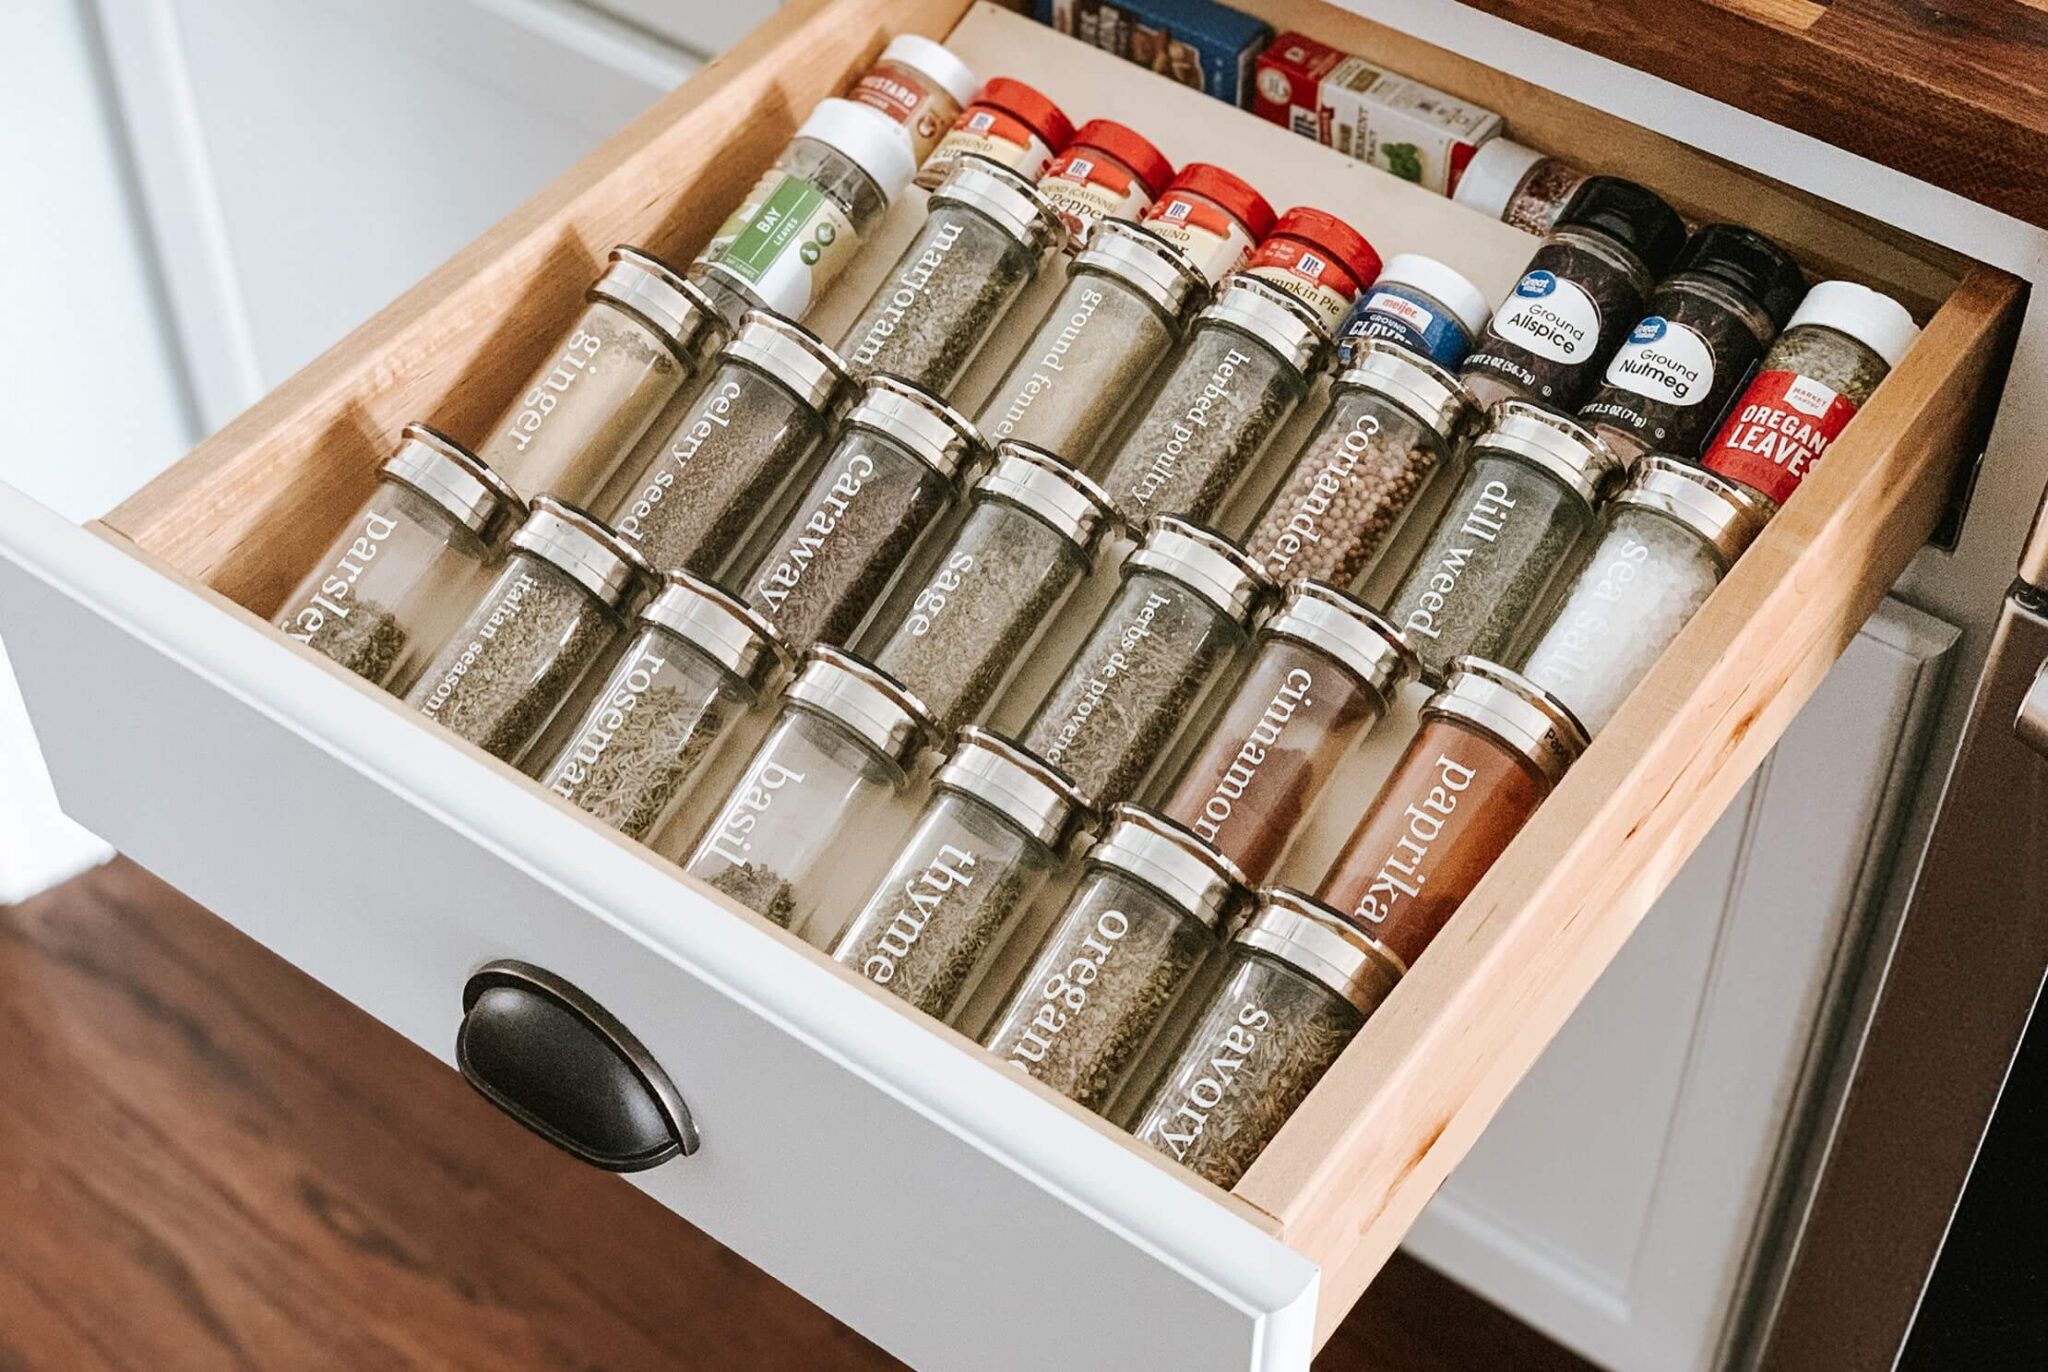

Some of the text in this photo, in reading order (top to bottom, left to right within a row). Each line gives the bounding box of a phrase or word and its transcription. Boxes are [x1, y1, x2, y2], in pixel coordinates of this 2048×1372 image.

[756, 206, 781, 233] BAY
[773, 217, 798, 246] LEAVES
[852, 222, 964, 366] marjoram
[1041, 288, 1102, 372] ground
[1319, 295, 1340, 315] Pie
[1369, 314, 1407, 333] GROUND
[1382, 298, 1418, 318] meijer
[1507, 313, 1575, 354] Allspice
[1529, 304, 1585, 341] Ground
[508, 330, 601, 451] ginger
[1502, 360, 1536, 386] (56.7g)
[1619, 359, 1689, 398] Nutmeg
[1640, 349, 1699, 382] Ground
[616, 381, 741, 541] celery seed
[1132, 349, 1251, 506] herbed poultry
[1621, 408, 1648, 428] (71g)
[1740, 404, 1828, 455] OREGAN
[758, 454, 874, 613] caraway
[1267, 414, 1380, 571] coriander
[904, 551, 974, 637] sage
[1405, 480, 1516, 639] dill weed
[1594, 540, 1649, 604] sea
[420, 573, 539, 722] italian seasoni
[1046, 592, 1172, 766] herbs de provenc
[551, 650, 665, 800] rosemar
[710, 761, 806, 868] basil
[1354, 752, 1477, 926] paprika
[863, 843, 977, 984] thyme
[1158, 1003, 1270, 1161] savory
